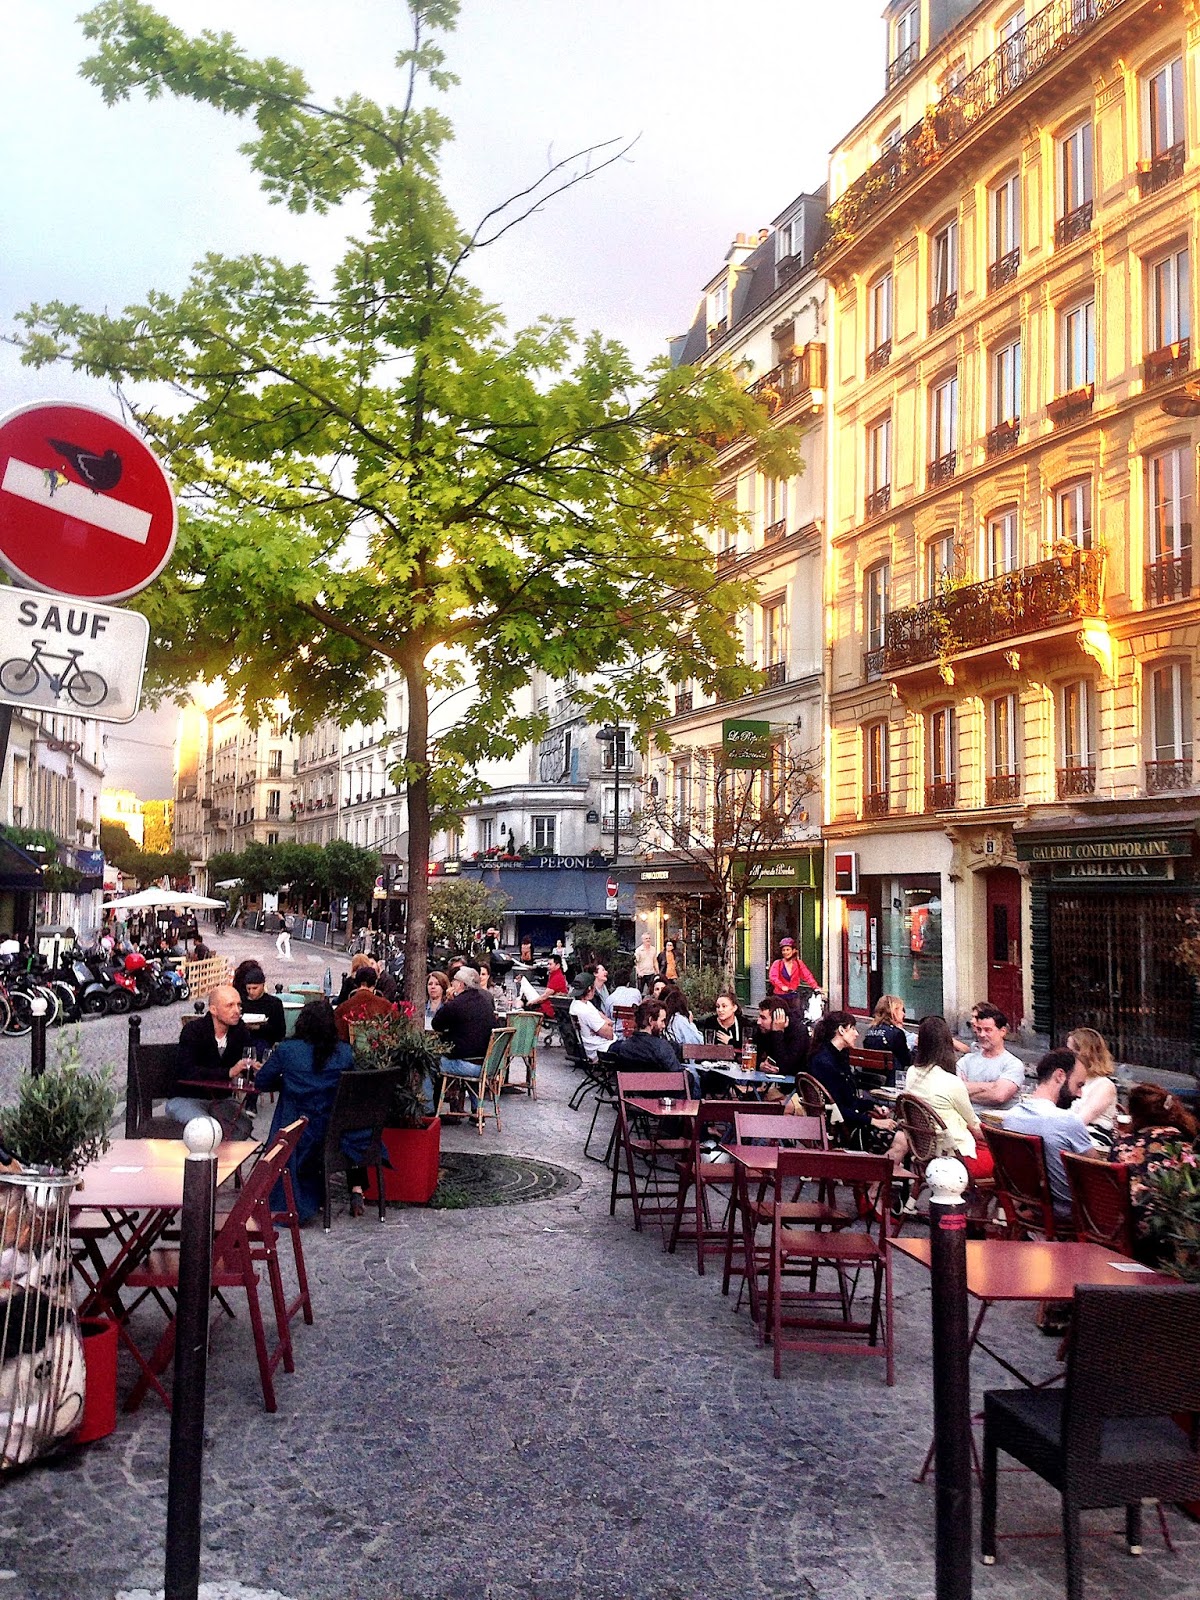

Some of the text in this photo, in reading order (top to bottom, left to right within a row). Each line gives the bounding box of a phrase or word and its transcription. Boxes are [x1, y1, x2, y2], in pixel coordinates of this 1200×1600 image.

[17, 600, 111, 640] SAUF
[1032, 840, 1170, 860] GALERIE CONTEMPORAINE
[539, 856, 597, 870] PEPONE
[1069, 862, 1149, 876] TABLEAUX
